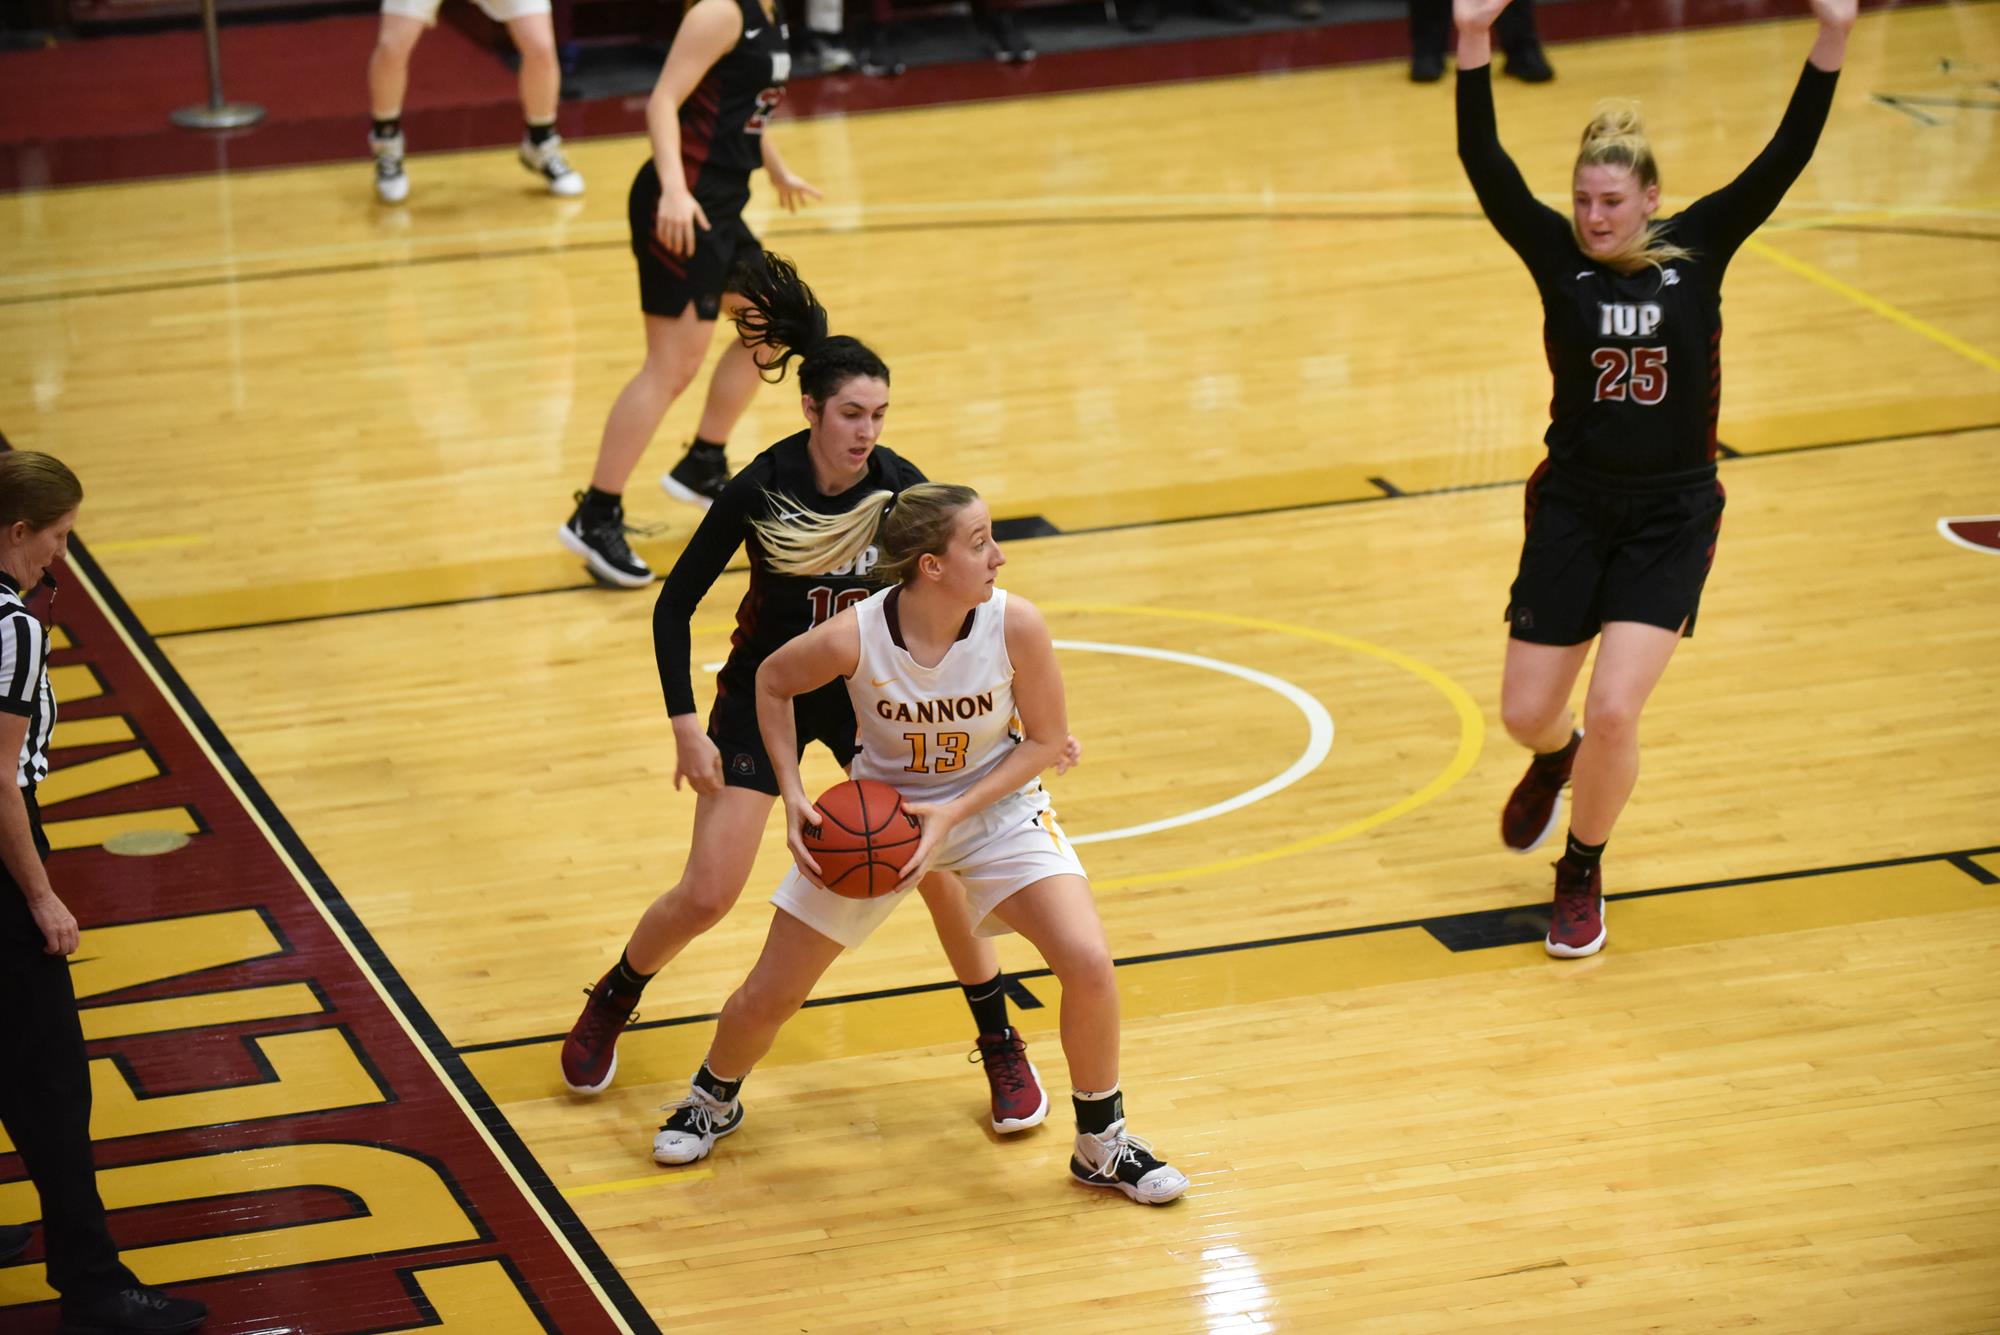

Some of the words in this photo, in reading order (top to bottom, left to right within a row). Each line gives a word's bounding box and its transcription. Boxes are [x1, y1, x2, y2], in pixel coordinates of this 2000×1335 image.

[1599, 302, 1662, 337] IUP
[1591, 346, 1668, 405] 25
[876, 691, 993, 723] GANNON
[903, 732, 970, 774] 13
